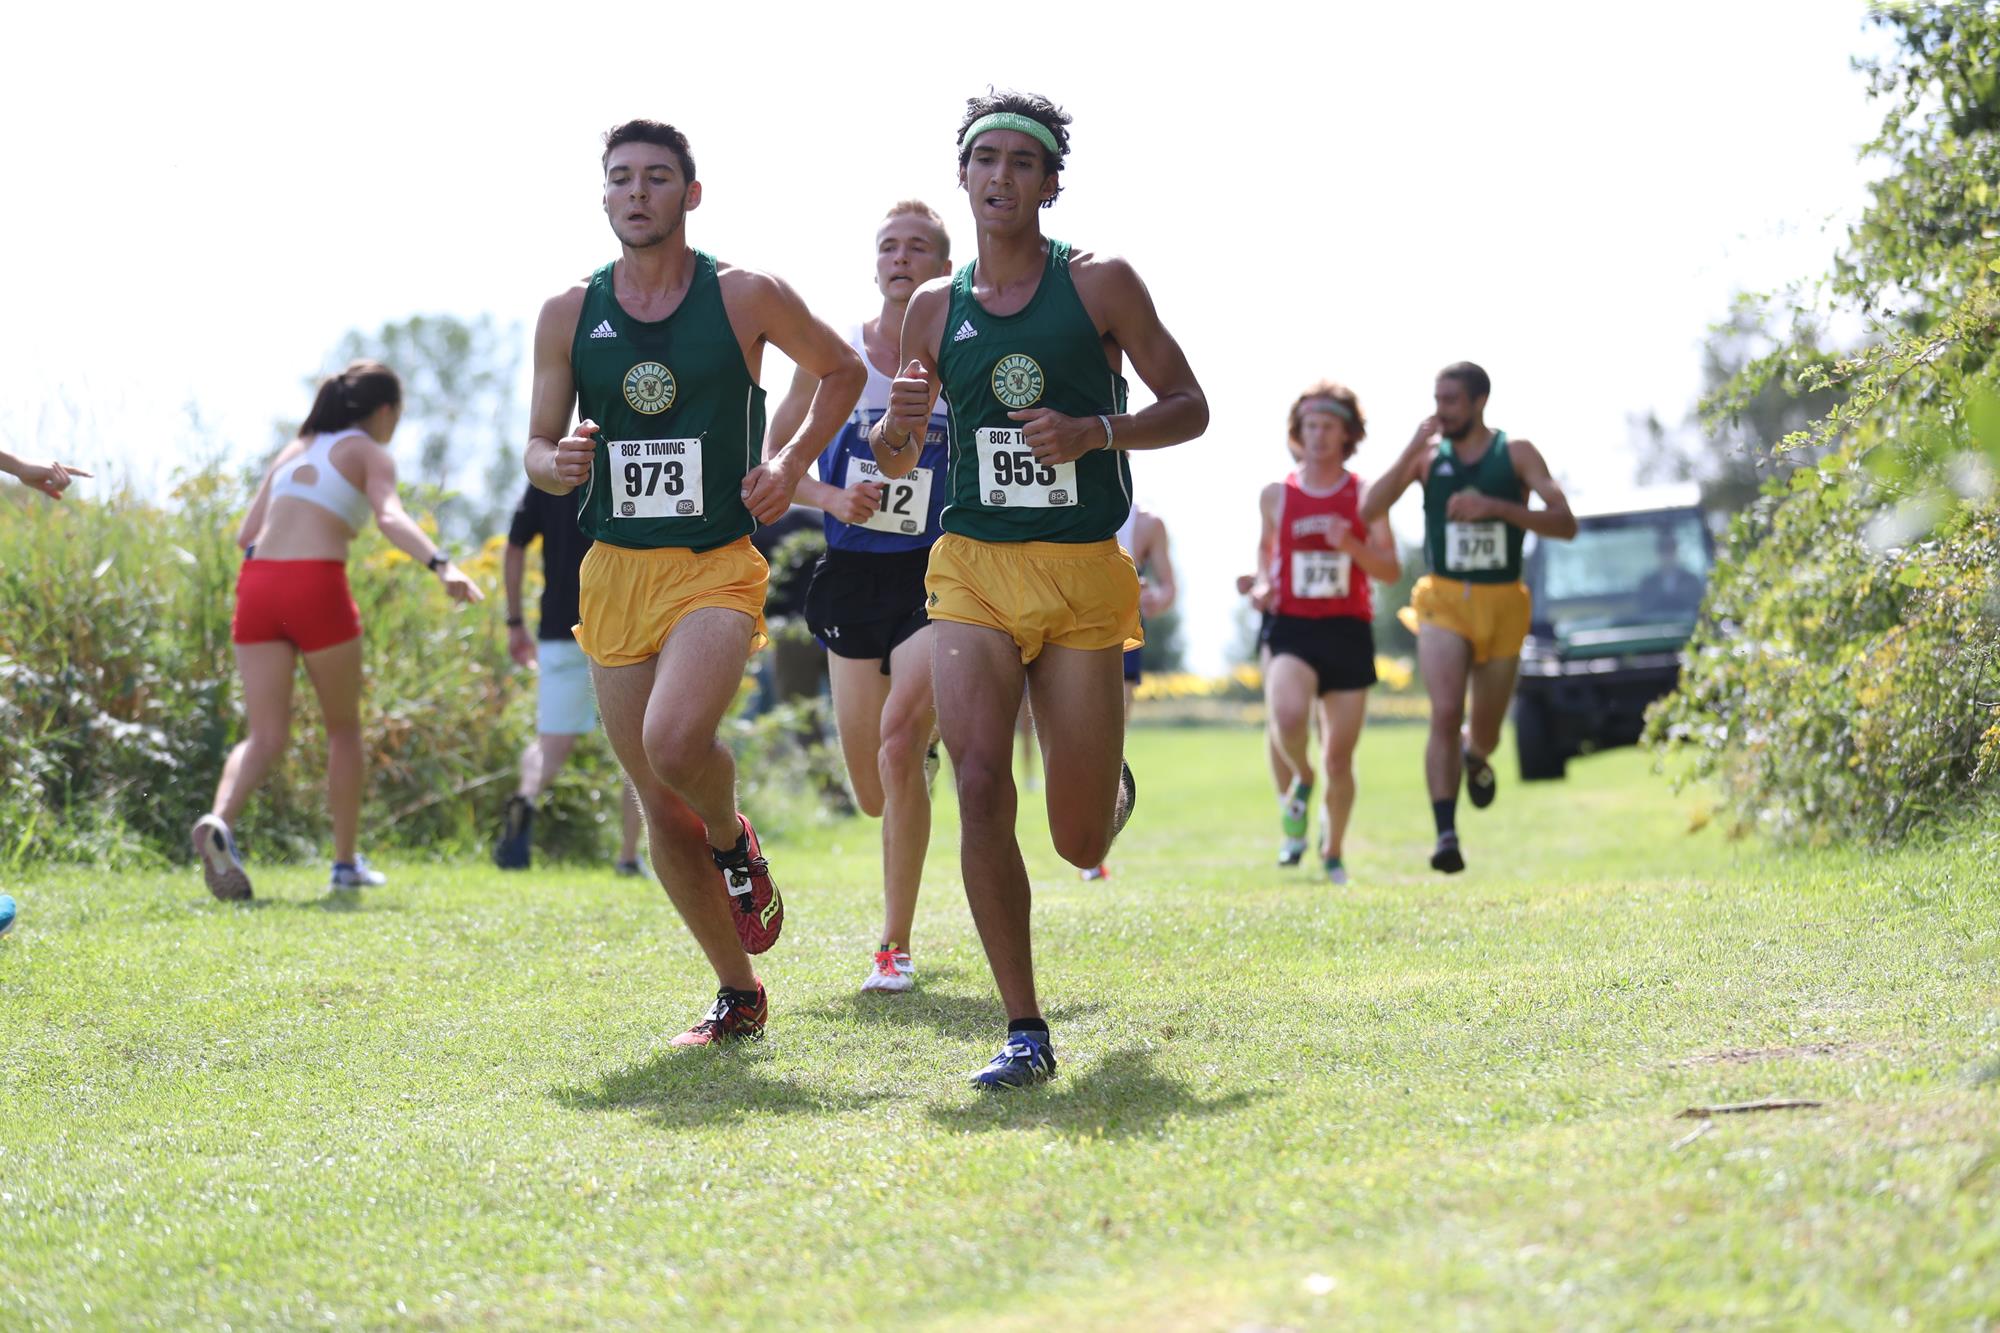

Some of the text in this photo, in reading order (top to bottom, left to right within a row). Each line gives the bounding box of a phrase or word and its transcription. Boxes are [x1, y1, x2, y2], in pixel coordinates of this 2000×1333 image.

[590, 331, 617, 339] adidas
[954, 330, 978, 342] adidas
[628, 364, 671, 383] VERMONT
[996, 357, 1038, 377] VERMONT
[626, 385, 673, 412] CATAMOUNTS
[995, 377, 1041, 405] CATAMOUNTS
[990, 431, 1012, 445] 802
[621, 441, 685, 457] 802 TIMING
[860, 462, 879, 476] 802
[993, 450, 1057, 486] 953
[624, 461, 685, 497] 973
[862, 479, 913, 516] 12
